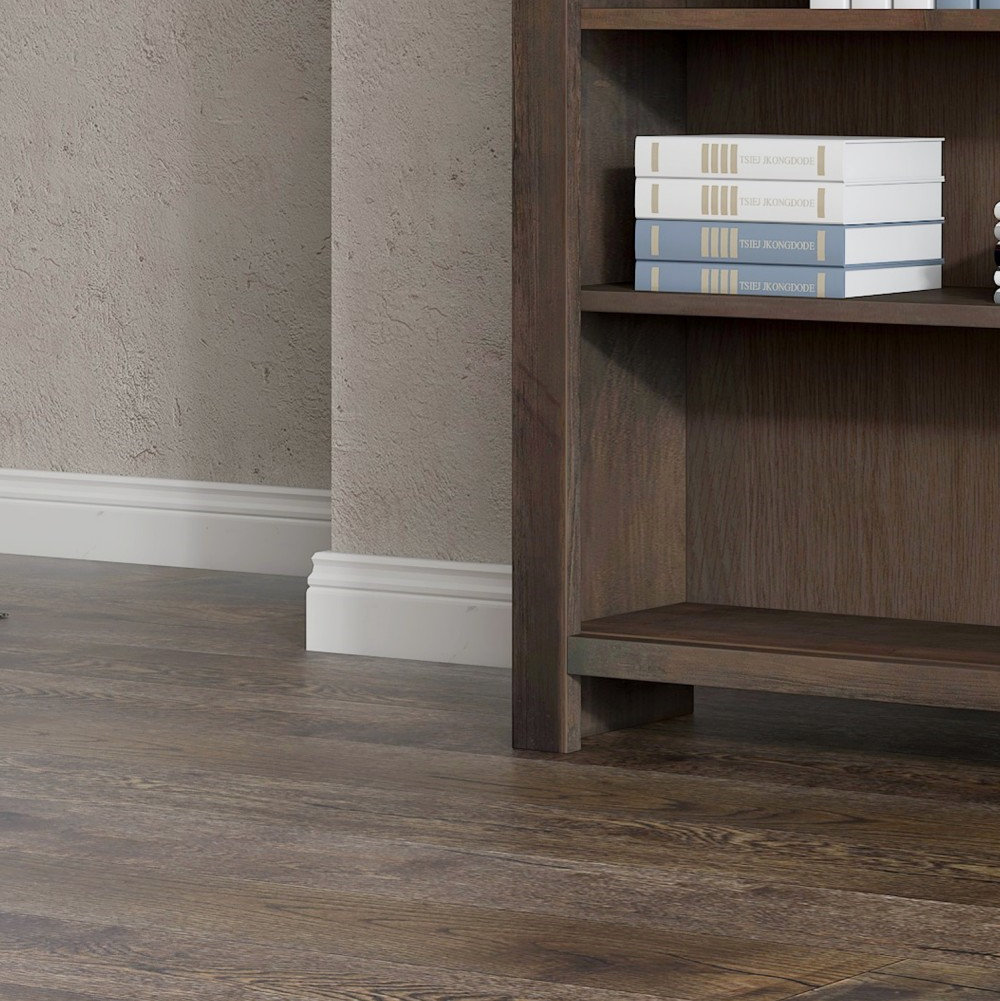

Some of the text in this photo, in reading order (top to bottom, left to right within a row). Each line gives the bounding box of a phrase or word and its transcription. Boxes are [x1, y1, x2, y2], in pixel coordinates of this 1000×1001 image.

[740, 155, 761, 165] TSIEJ
[740, 197, 761, 207] TSIEJ
[739, 239, 761, 249] TSIEJ
[739, 281, 761, 291] TSIEJ
